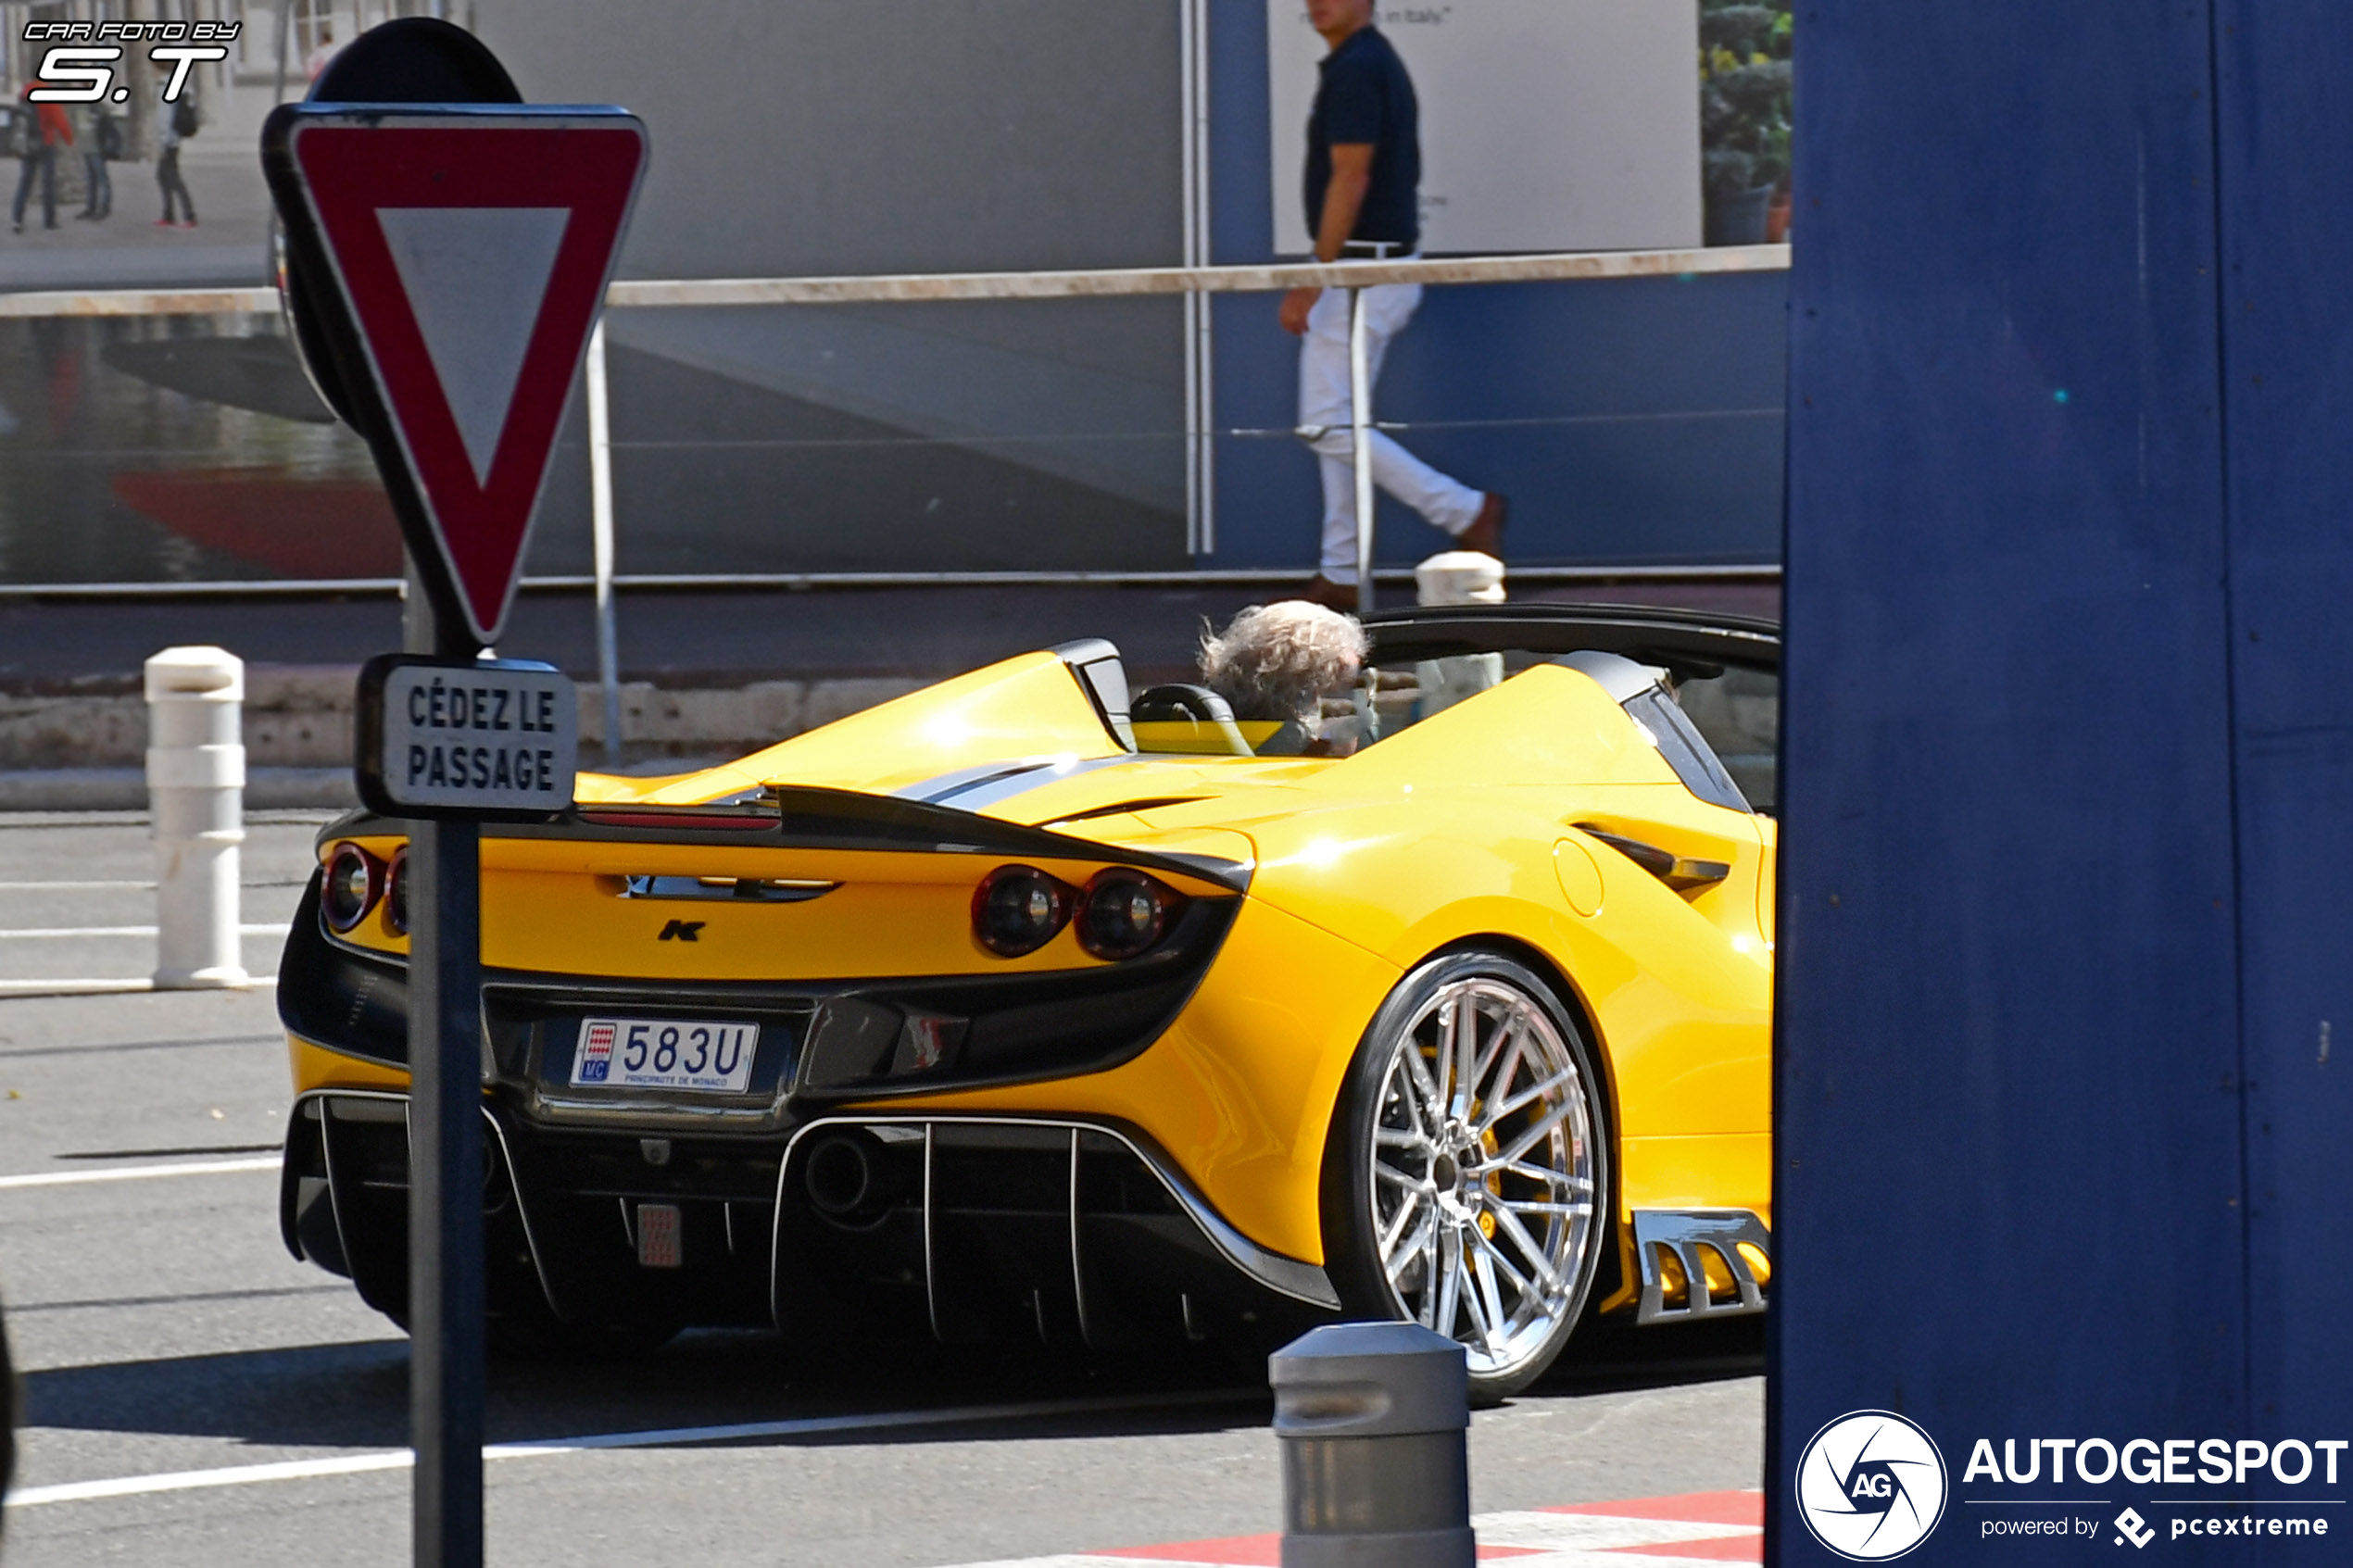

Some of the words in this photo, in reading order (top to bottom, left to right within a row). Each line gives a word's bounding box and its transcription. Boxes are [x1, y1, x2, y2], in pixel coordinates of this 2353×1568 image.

[409, 677, 510, 731] CÉDEZ
[519, 690, 555, 733] LE
[409, 745, 554, 792] PASSAGE
[585, 1061, 605, 1078] MC
[623, 1025, 744, 1075] 583U
[678, 1076, 690, 1085] DE
[692, 1077, 727, 1087] MONACO
